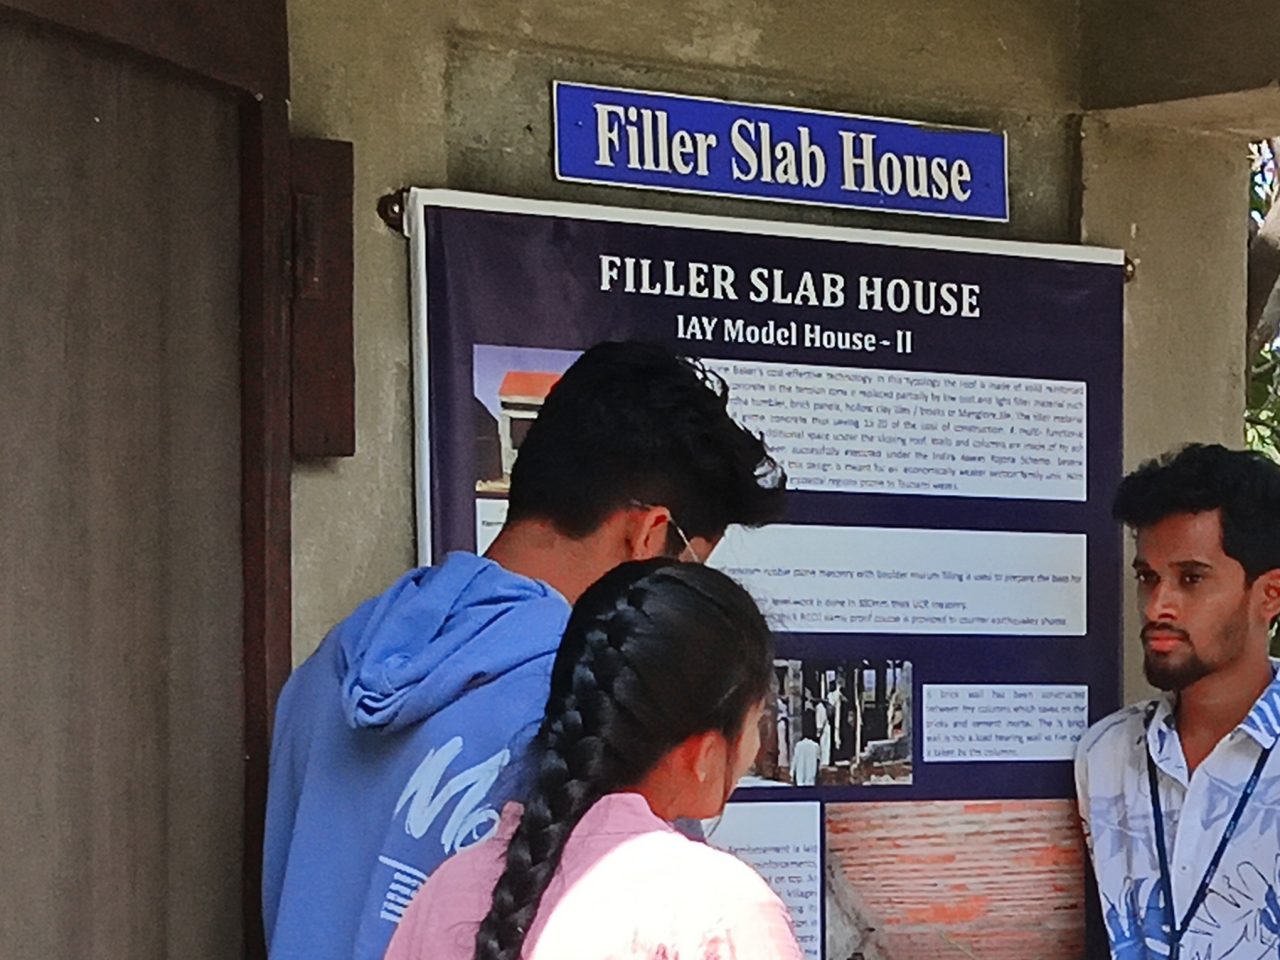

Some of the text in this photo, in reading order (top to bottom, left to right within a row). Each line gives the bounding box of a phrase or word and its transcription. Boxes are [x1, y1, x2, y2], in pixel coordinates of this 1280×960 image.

[594, 103, 973, 202] Filler Slab House
[600, 255, 981, 318] FILLER SLAB HOUSE
[676, 314, 718, 341] IAY
[724, 319, 797, 346] Model
[804, 324, 876, 352] House
[896, 330, 913, 353] II
